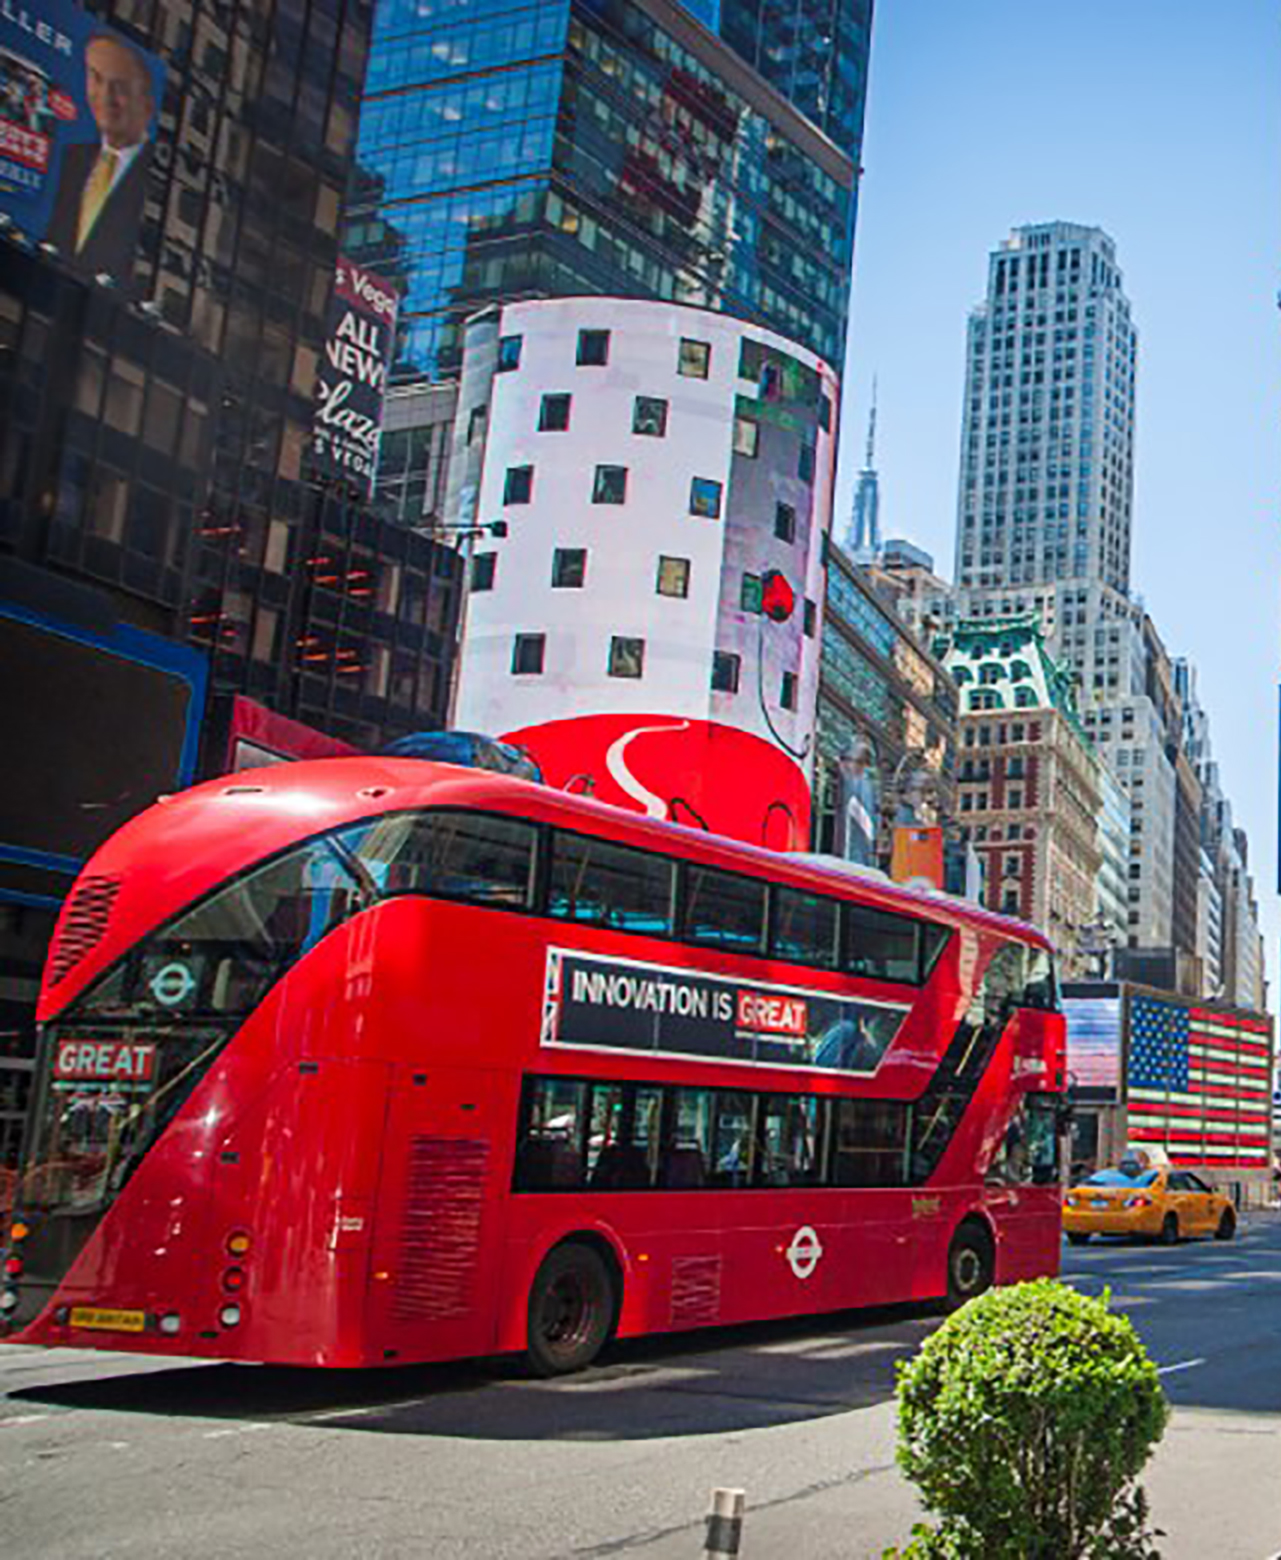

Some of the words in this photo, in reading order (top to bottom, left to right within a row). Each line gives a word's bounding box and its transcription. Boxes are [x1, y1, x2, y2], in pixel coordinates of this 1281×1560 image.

[336, 311, 381, 356] ALL
[572, 970, 708, 1019] INNOVATION
[713, 991, 733, 1021] IS
[739, 996, 806, 1030] GREAT
[59, 1043, 154, 1075] GREAT
